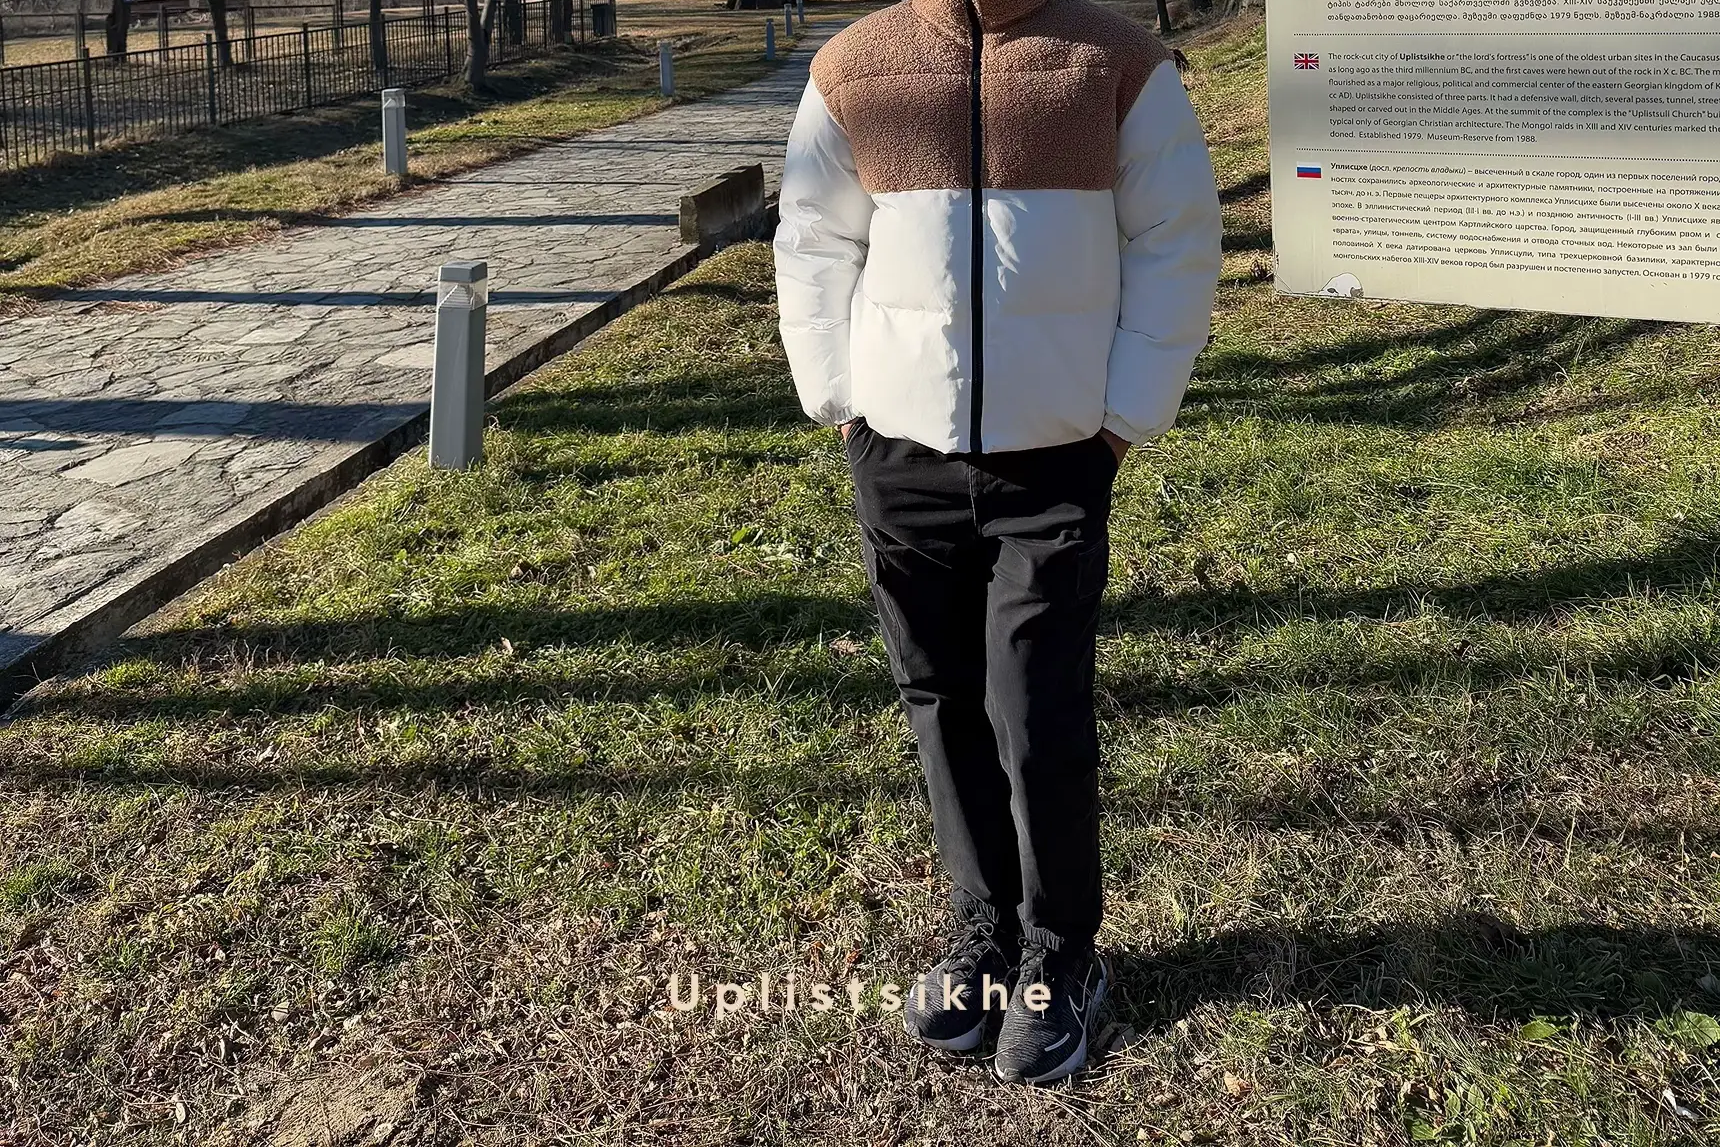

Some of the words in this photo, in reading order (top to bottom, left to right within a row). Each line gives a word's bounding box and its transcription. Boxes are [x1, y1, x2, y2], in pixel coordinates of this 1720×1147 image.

[1343, 53, 1373, 61] rock-cut
[1399, 52, 1445, 62] Uplistsikhe
[1580, 53, 1606, 62] oldest
[1607, 53, 1632, 62] urban
[1414, 66, 1459, 74] millennium
[1328, 78, 1366, 87] flourished
[1382, 79, 1404, 89] major
[1406, 79, 1441, 89] religious,
[1442, 80, 1473, 89] political
[1491, 80, 1537, 89] commercial
[1623, 81, 1662, 92] Georgian
[1664, 81, 1703, 92] kingdom
[1355, 92, 1396, 101] Uplistsikhe
[1397, 93, 1434, 101] consisted
[1466, 94, 1488, 103] parts.
[1519, 94, 1559, 103] defensive
[1580, 94, 1603, 104] ditch,
[1604, 95, 1633, 104] several
[1635, 97, 1665, 105] passes,
[1665, 96, 1696, 105] tunnel,
[1329, 104, 1356, 114] shaped
[1366, 105, 1393, 113] carved
[1432, 106, 1460, 115] Middle
[1510, 108, 1541, 116] summit
[1567, 109, 1603, 118] complex
[1329, 117, 1354, 127] typical
[1382, 118, 1417, 128] Georgian
[1418, 119, 1453, 128] Christian
[1454, 120, 1504, 129] architecture.
[1521, 121, 1552, 131] Mongol
[1633, 124, 1672, 132] centuries
[1674, 124, 1706, 133] marked
[1358, 130, 1401, 140] Established
[1403, 132, 1423, 140] 1979.
[1426, 132, 1494, 142] Museum-Reserve
[1516, 134, 1537, 143] 1988.
[1474, 168, 1524, 176] высеченный
[1650, 174, 1697, 182] поселений
[1357, 177, 1407, 186] сохранились
[1597, 186, 1653, 195] построенные
[1510, 197, 1553, 205] комплекса
[1554, 197, 1598, 207] Уплисцихе
[1622, 201, 1664, 209] высечены
[1576, 212, 1623, 221] античность
[1661, 214, 1707, 225] Уплисцихе
[1579, 226, 1634, 235] защищенный
[1636, 228, 1677, 238] глубоким
[1332, 240, 1374, 248] половиной
[1405, 244, 1451, 253] датирована
[1616, 241, 1663, 251] Некоторые
[1333, 253, 1380, 261] монгольских
[1506, 263, 1545, 272] разрушен
[1553, 266, 1602, 275] постепенно
[1642, 269, 1680, 279] Основан
